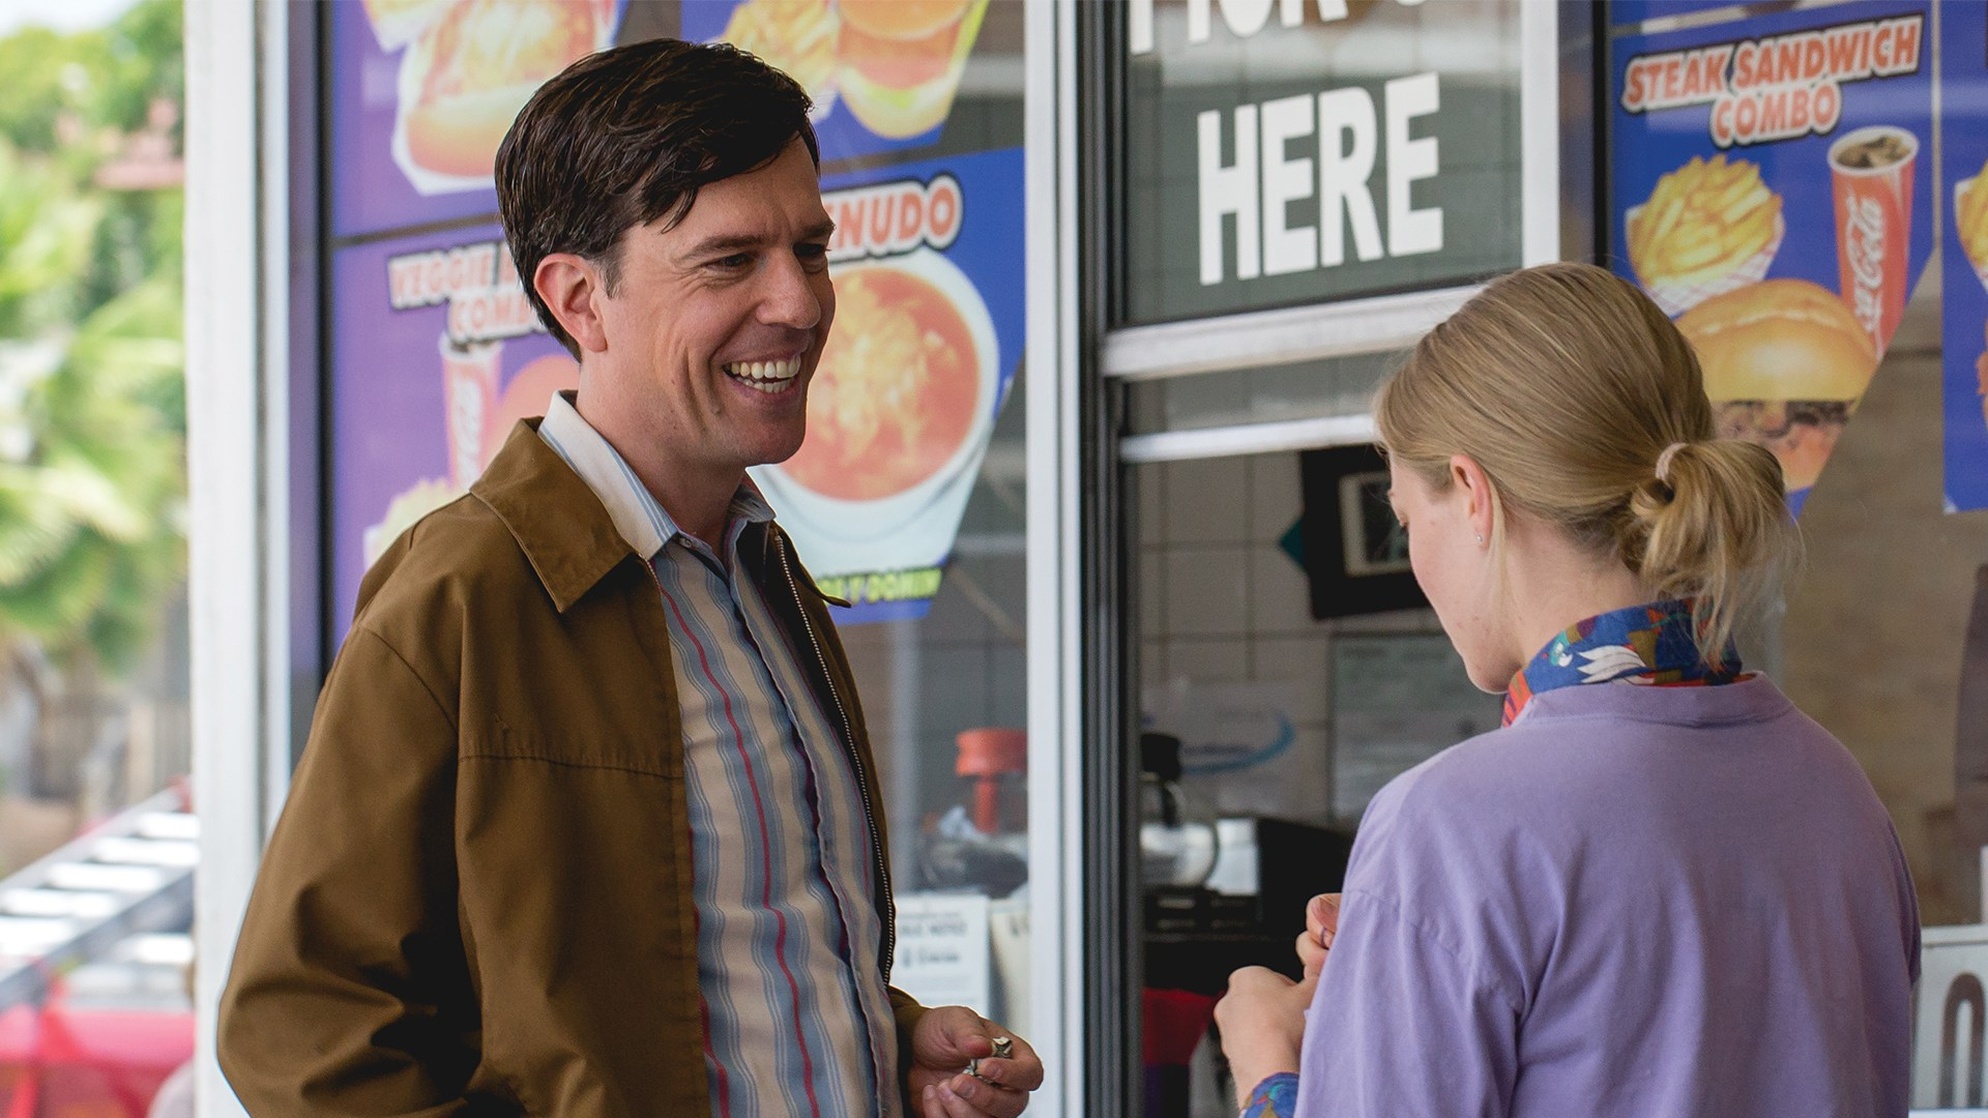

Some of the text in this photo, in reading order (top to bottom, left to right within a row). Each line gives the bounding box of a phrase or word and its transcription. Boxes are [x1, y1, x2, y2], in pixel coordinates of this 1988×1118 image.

[1624, 22, 1921, 107] STEAK SANDWICH
[1713, 82, 1840, 142] COMBO
[1198, 71, 1443, 286] HERE
[826, 184, 957, 251] NUDO
